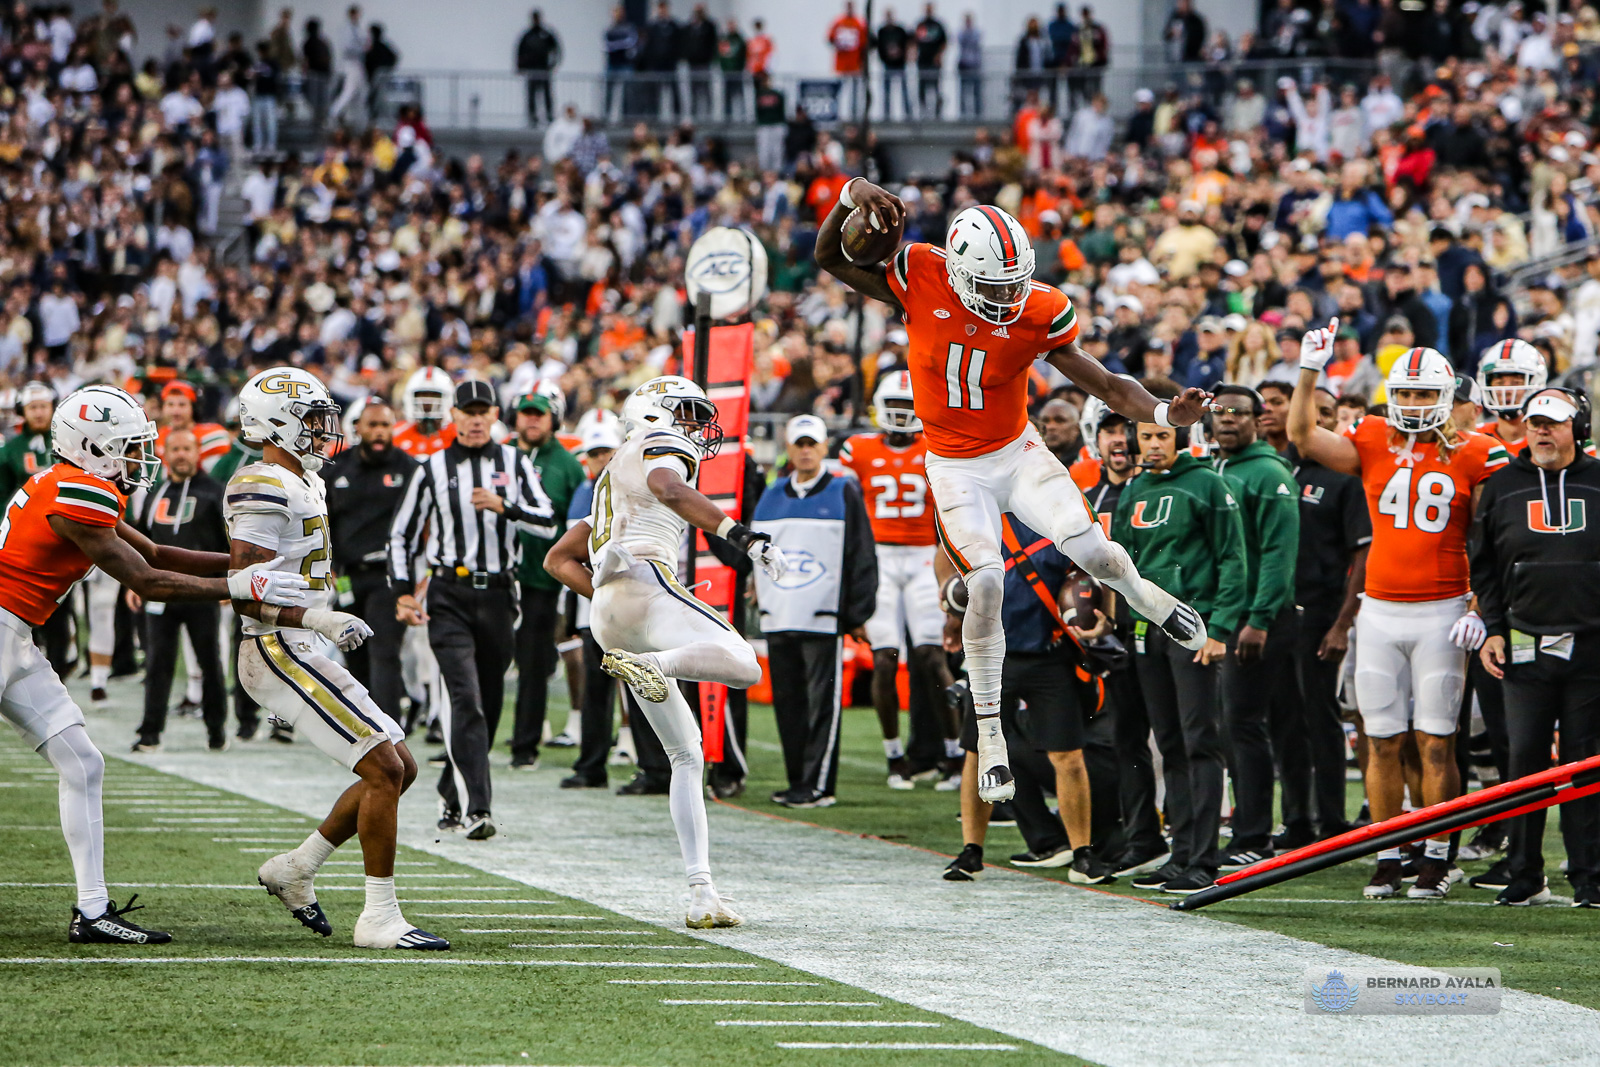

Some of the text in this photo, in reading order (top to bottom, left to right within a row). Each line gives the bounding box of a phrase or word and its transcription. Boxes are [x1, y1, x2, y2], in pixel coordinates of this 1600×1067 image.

[699, 259, 743, 276] ACC
[260, 373, 310, 398] GT
[945, 341, 987, 411] 11
[870, 472, 928, 520] 23
[1130, 495, 1174, 530] U
[1377, 466, 1457, 534] 48
[1527, 498, 1587, 534] U
[299, 513, 333, 591] 2
